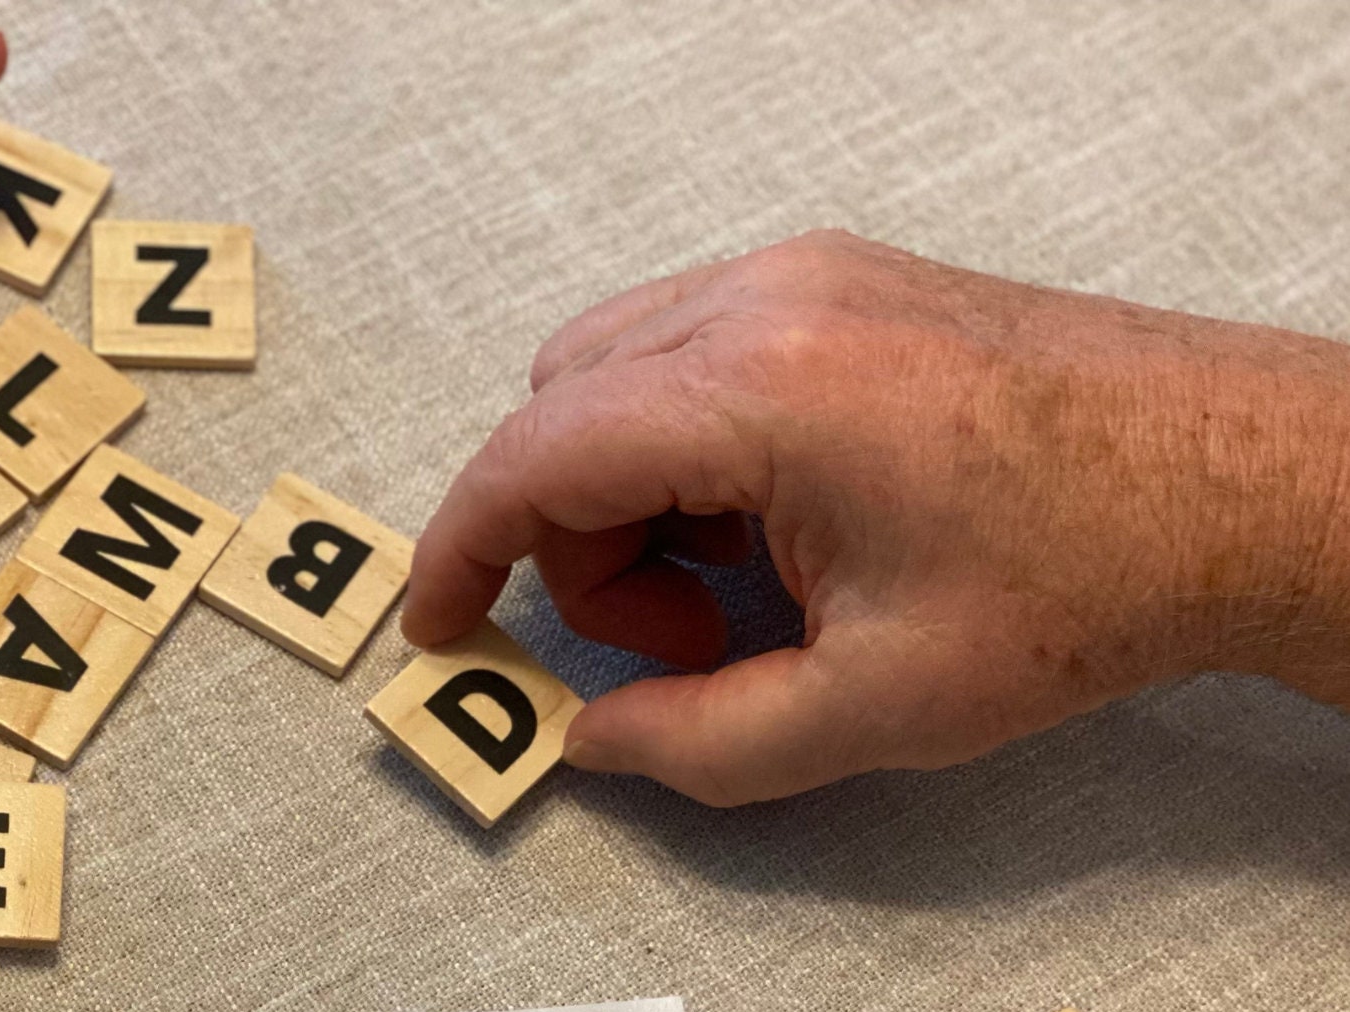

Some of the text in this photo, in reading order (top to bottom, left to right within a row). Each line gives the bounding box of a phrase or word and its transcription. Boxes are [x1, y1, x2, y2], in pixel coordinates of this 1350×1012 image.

[58, 473, 204, 602] M
[266, 520, 375, 619] B
[423, 668, 539, 776] D
